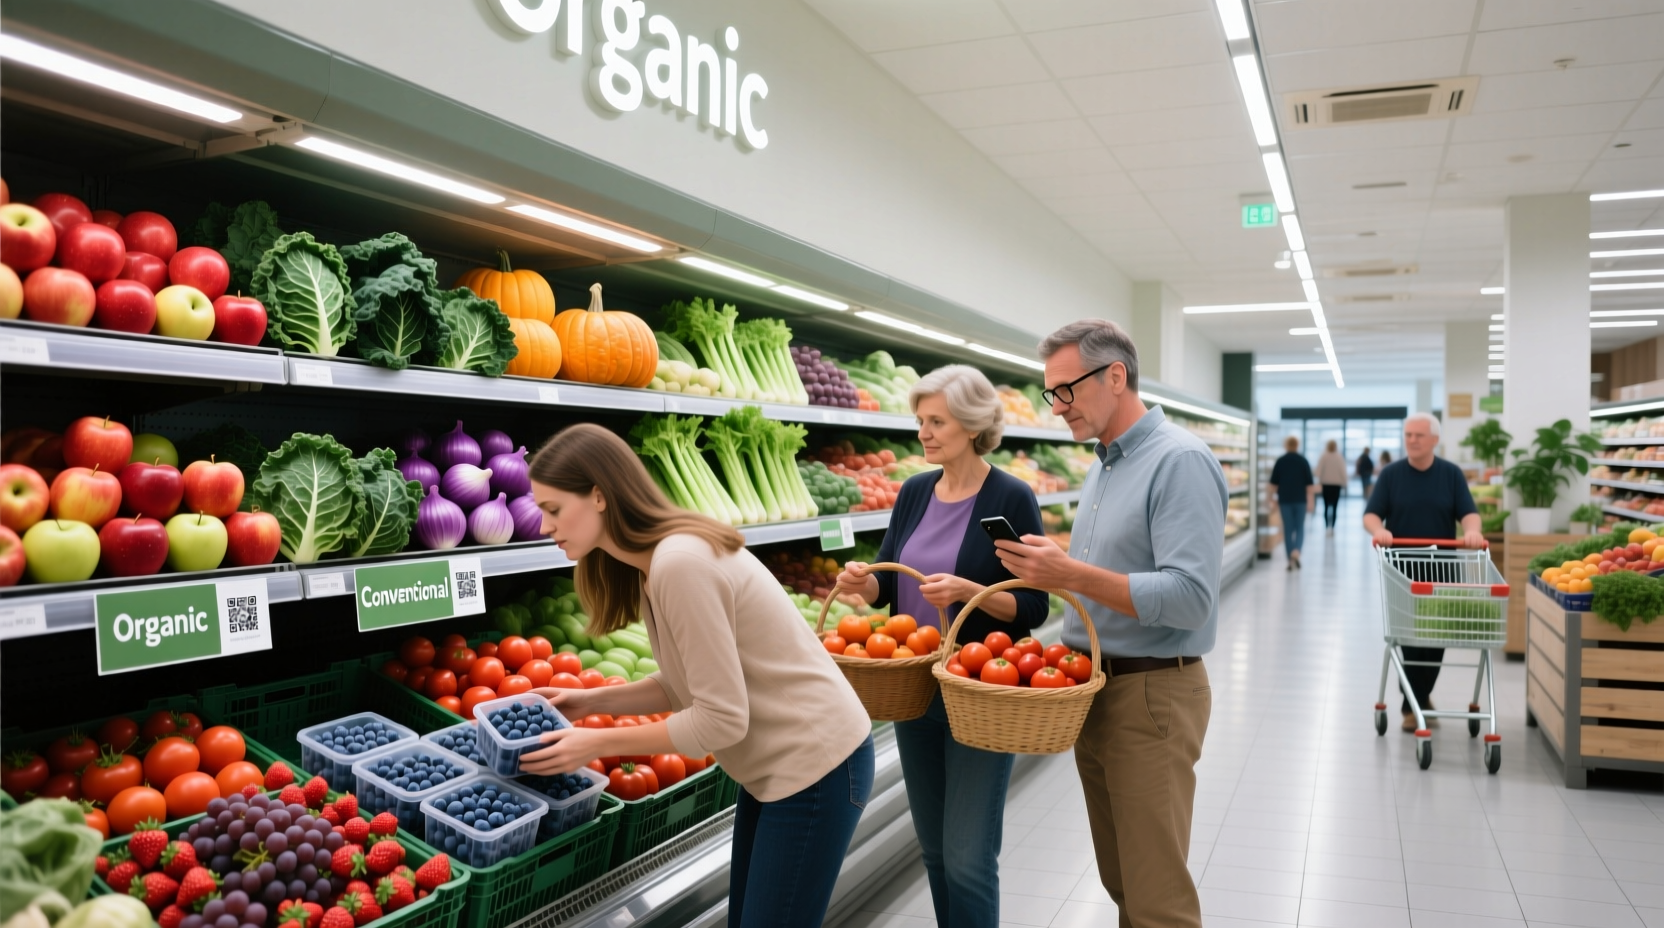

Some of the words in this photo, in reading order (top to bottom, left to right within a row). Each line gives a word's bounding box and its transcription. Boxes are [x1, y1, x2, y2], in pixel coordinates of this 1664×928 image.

[500, 0, 769, 149] ganic
[361, 576, 449, 608] Conventional
[112, 605, 209, 648] Organic
